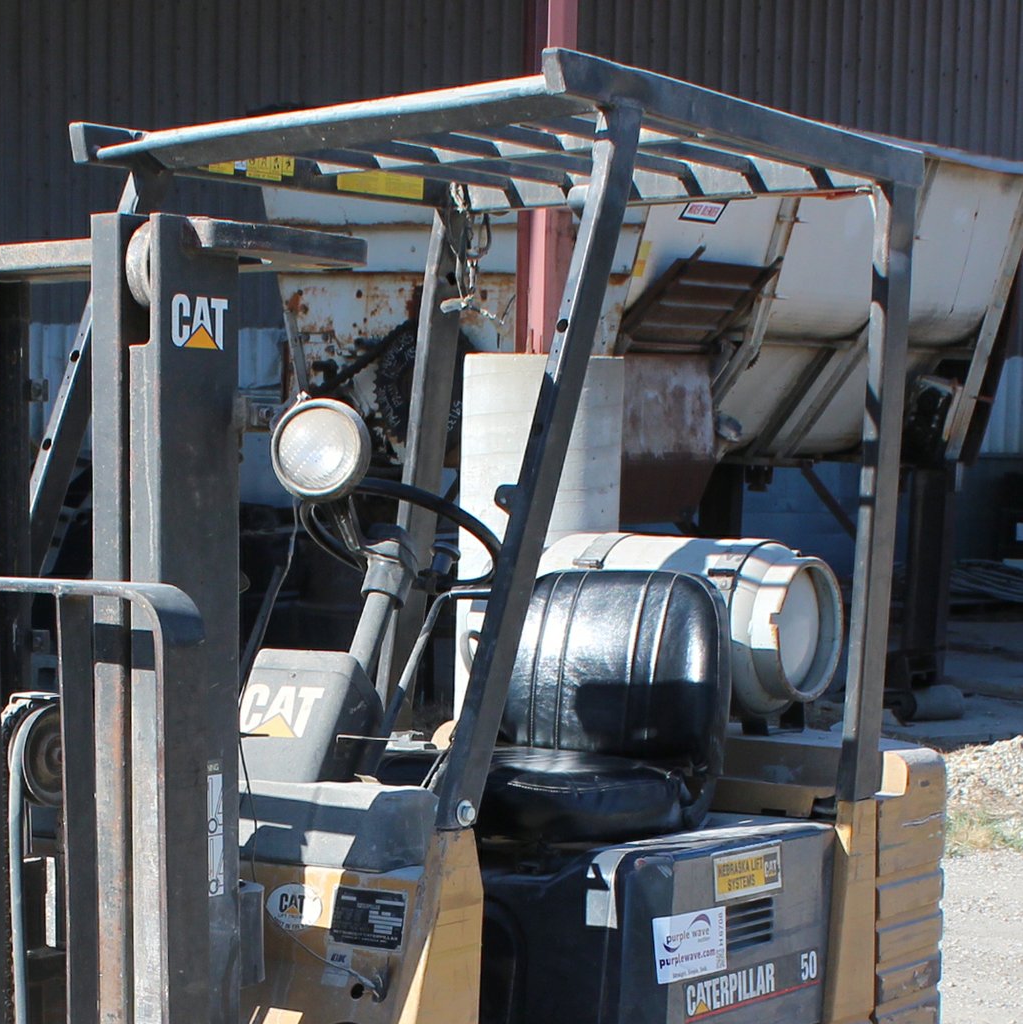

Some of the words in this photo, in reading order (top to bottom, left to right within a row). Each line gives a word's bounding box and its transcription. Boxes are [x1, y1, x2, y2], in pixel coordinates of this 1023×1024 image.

[171, 293, 228, 351] CAT
[239, 683, 325, 738] CAT
[718, 858, 750, 878] NEBRASKA
[751, 856, 763, 871] LIFT
[764, 859, 777, 878] CAT
[727, 873, 756, 891] SYSTEMS
[279, 892, 306, 915] CAT
[666, 930, 690, 945] purple
[692, 927, 710, 937] wave
[659, 948, 716, 970] purplewave.com
[686, 962, 775, 1016] CATERPILLAR
[800, 950, 818, 981] 50
